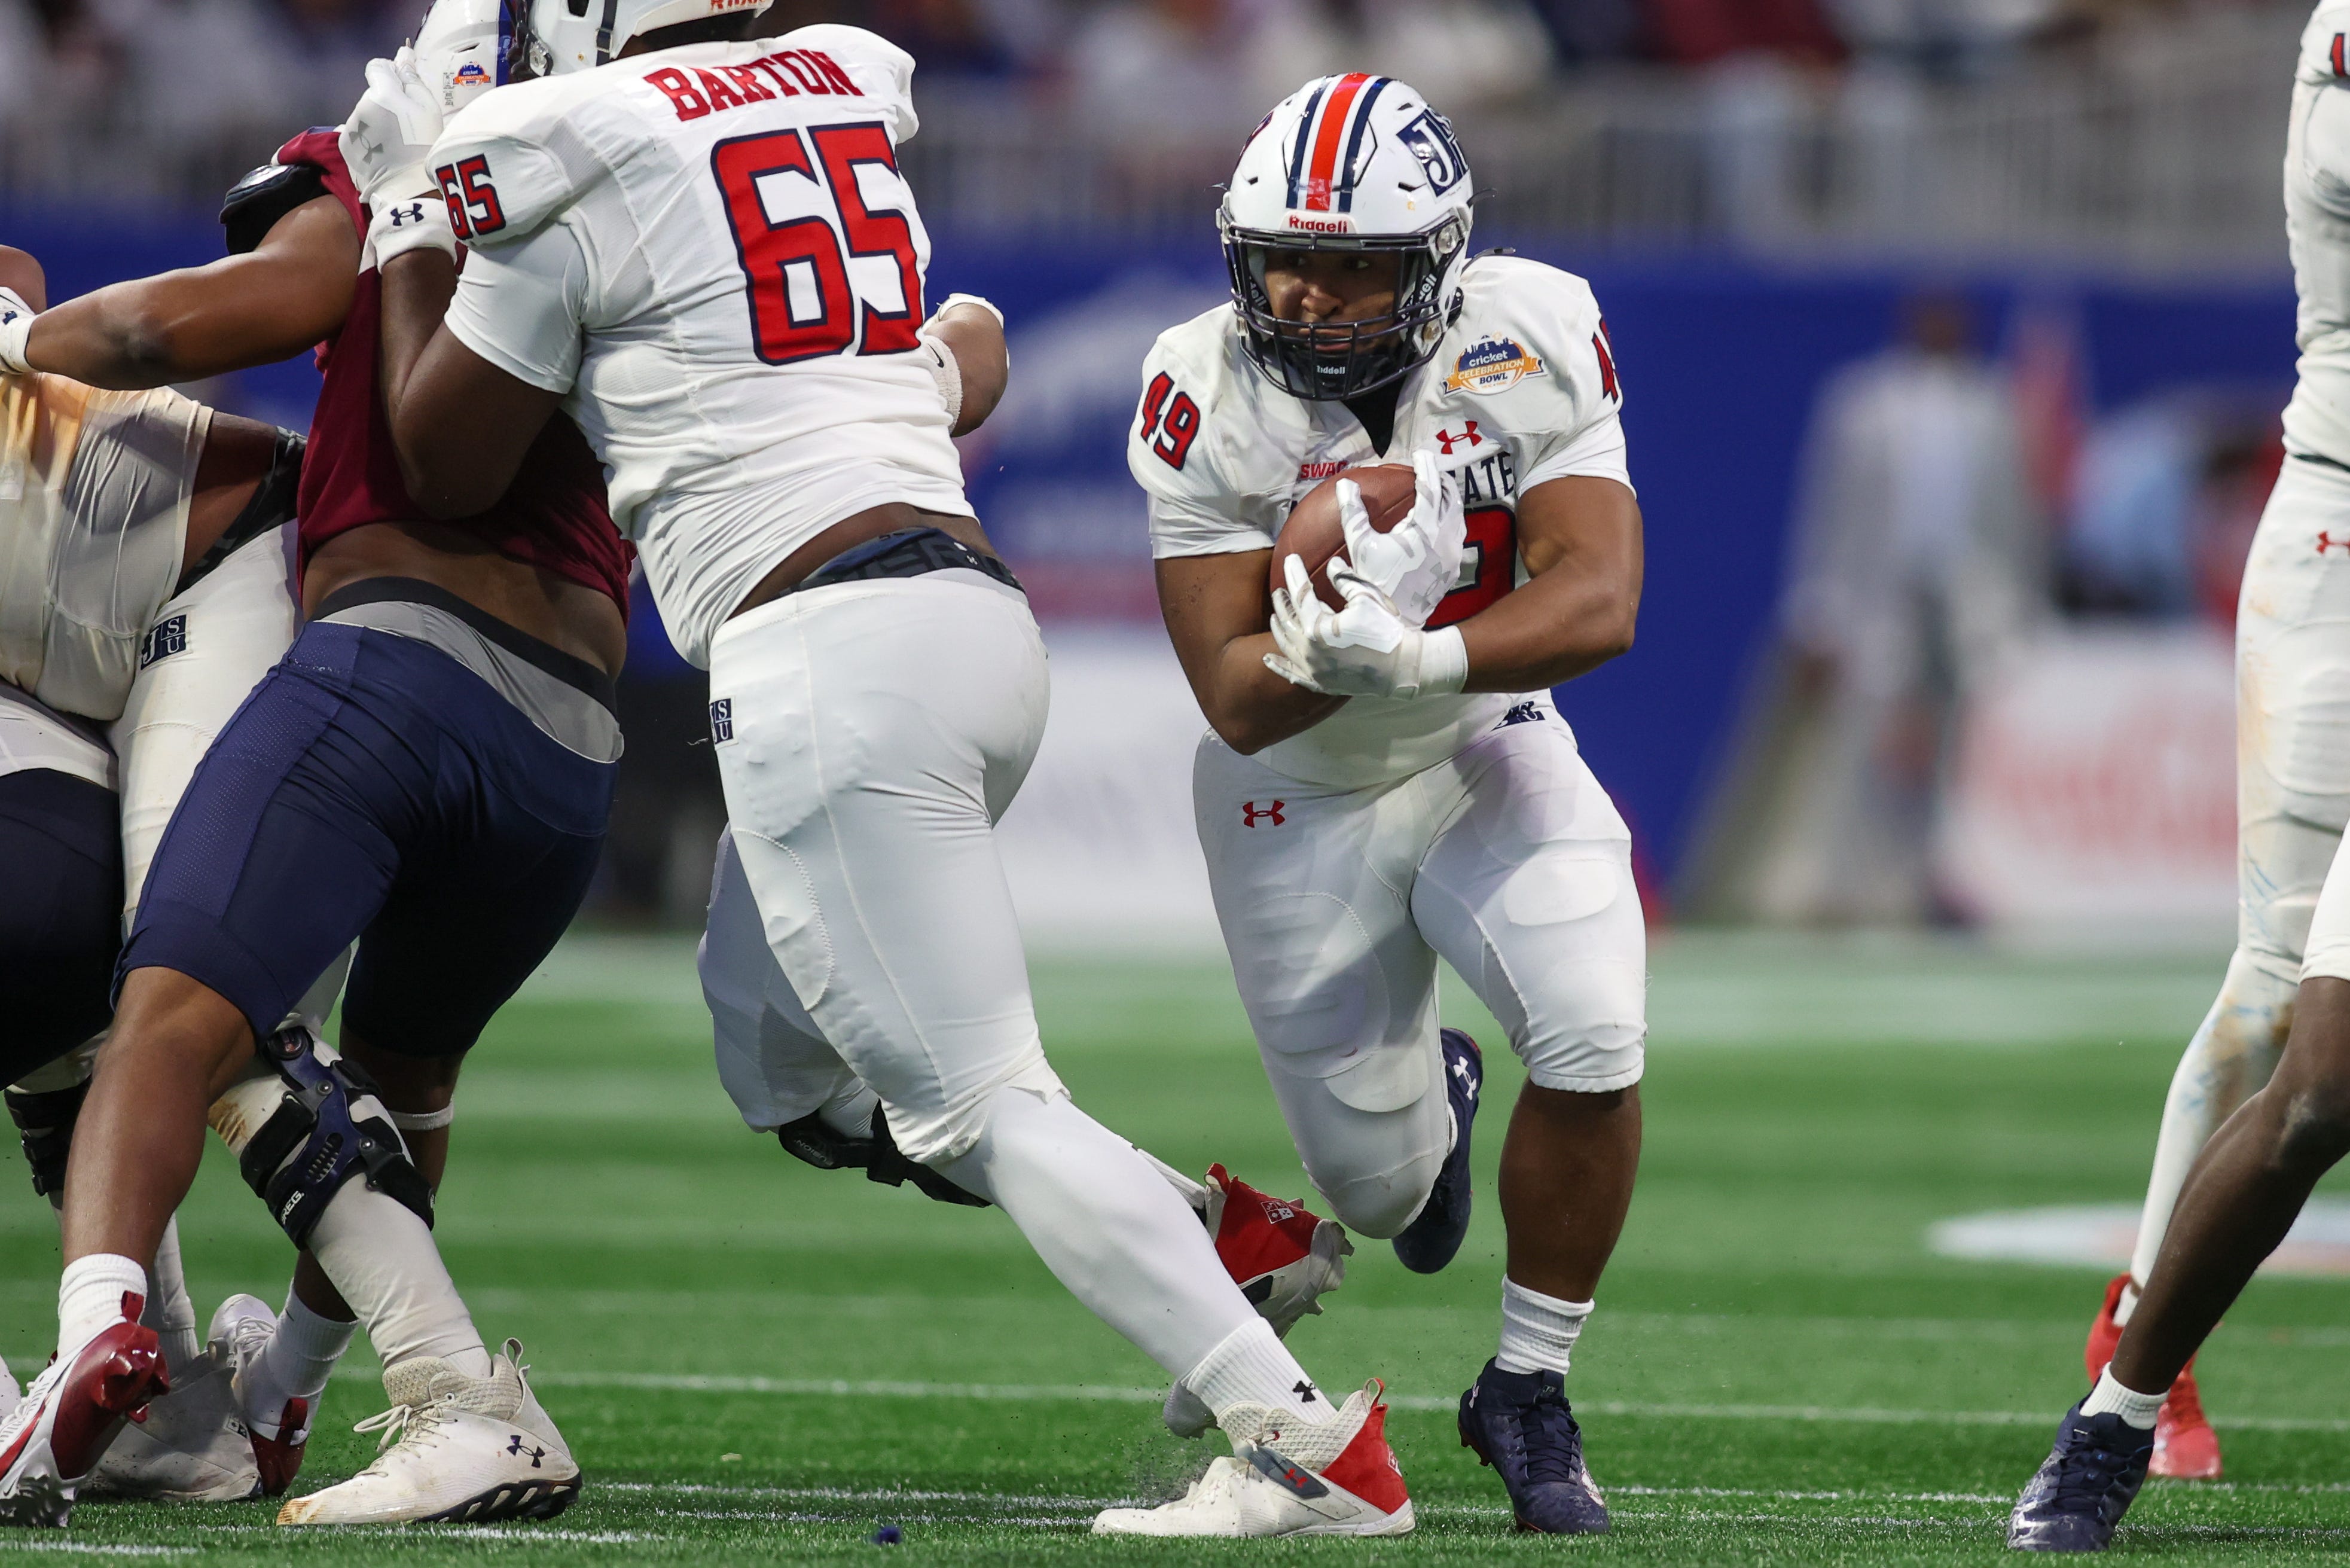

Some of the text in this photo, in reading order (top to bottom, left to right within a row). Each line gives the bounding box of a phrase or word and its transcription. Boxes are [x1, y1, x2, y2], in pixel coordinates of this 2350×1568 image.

[643, 49, 865, 122] BARTON
[435, 152, 506, 240] 65
[710, 121, 924, 367] 65
[1458, 359, 1525, 380] CELEBRATION
[1469, 350, 1508, 367] cricket
[1479, 372, 1508, 385] BOWL
[1141, 370, 1201, 472] 49
[1445, 450, 1515, 505] ATE
